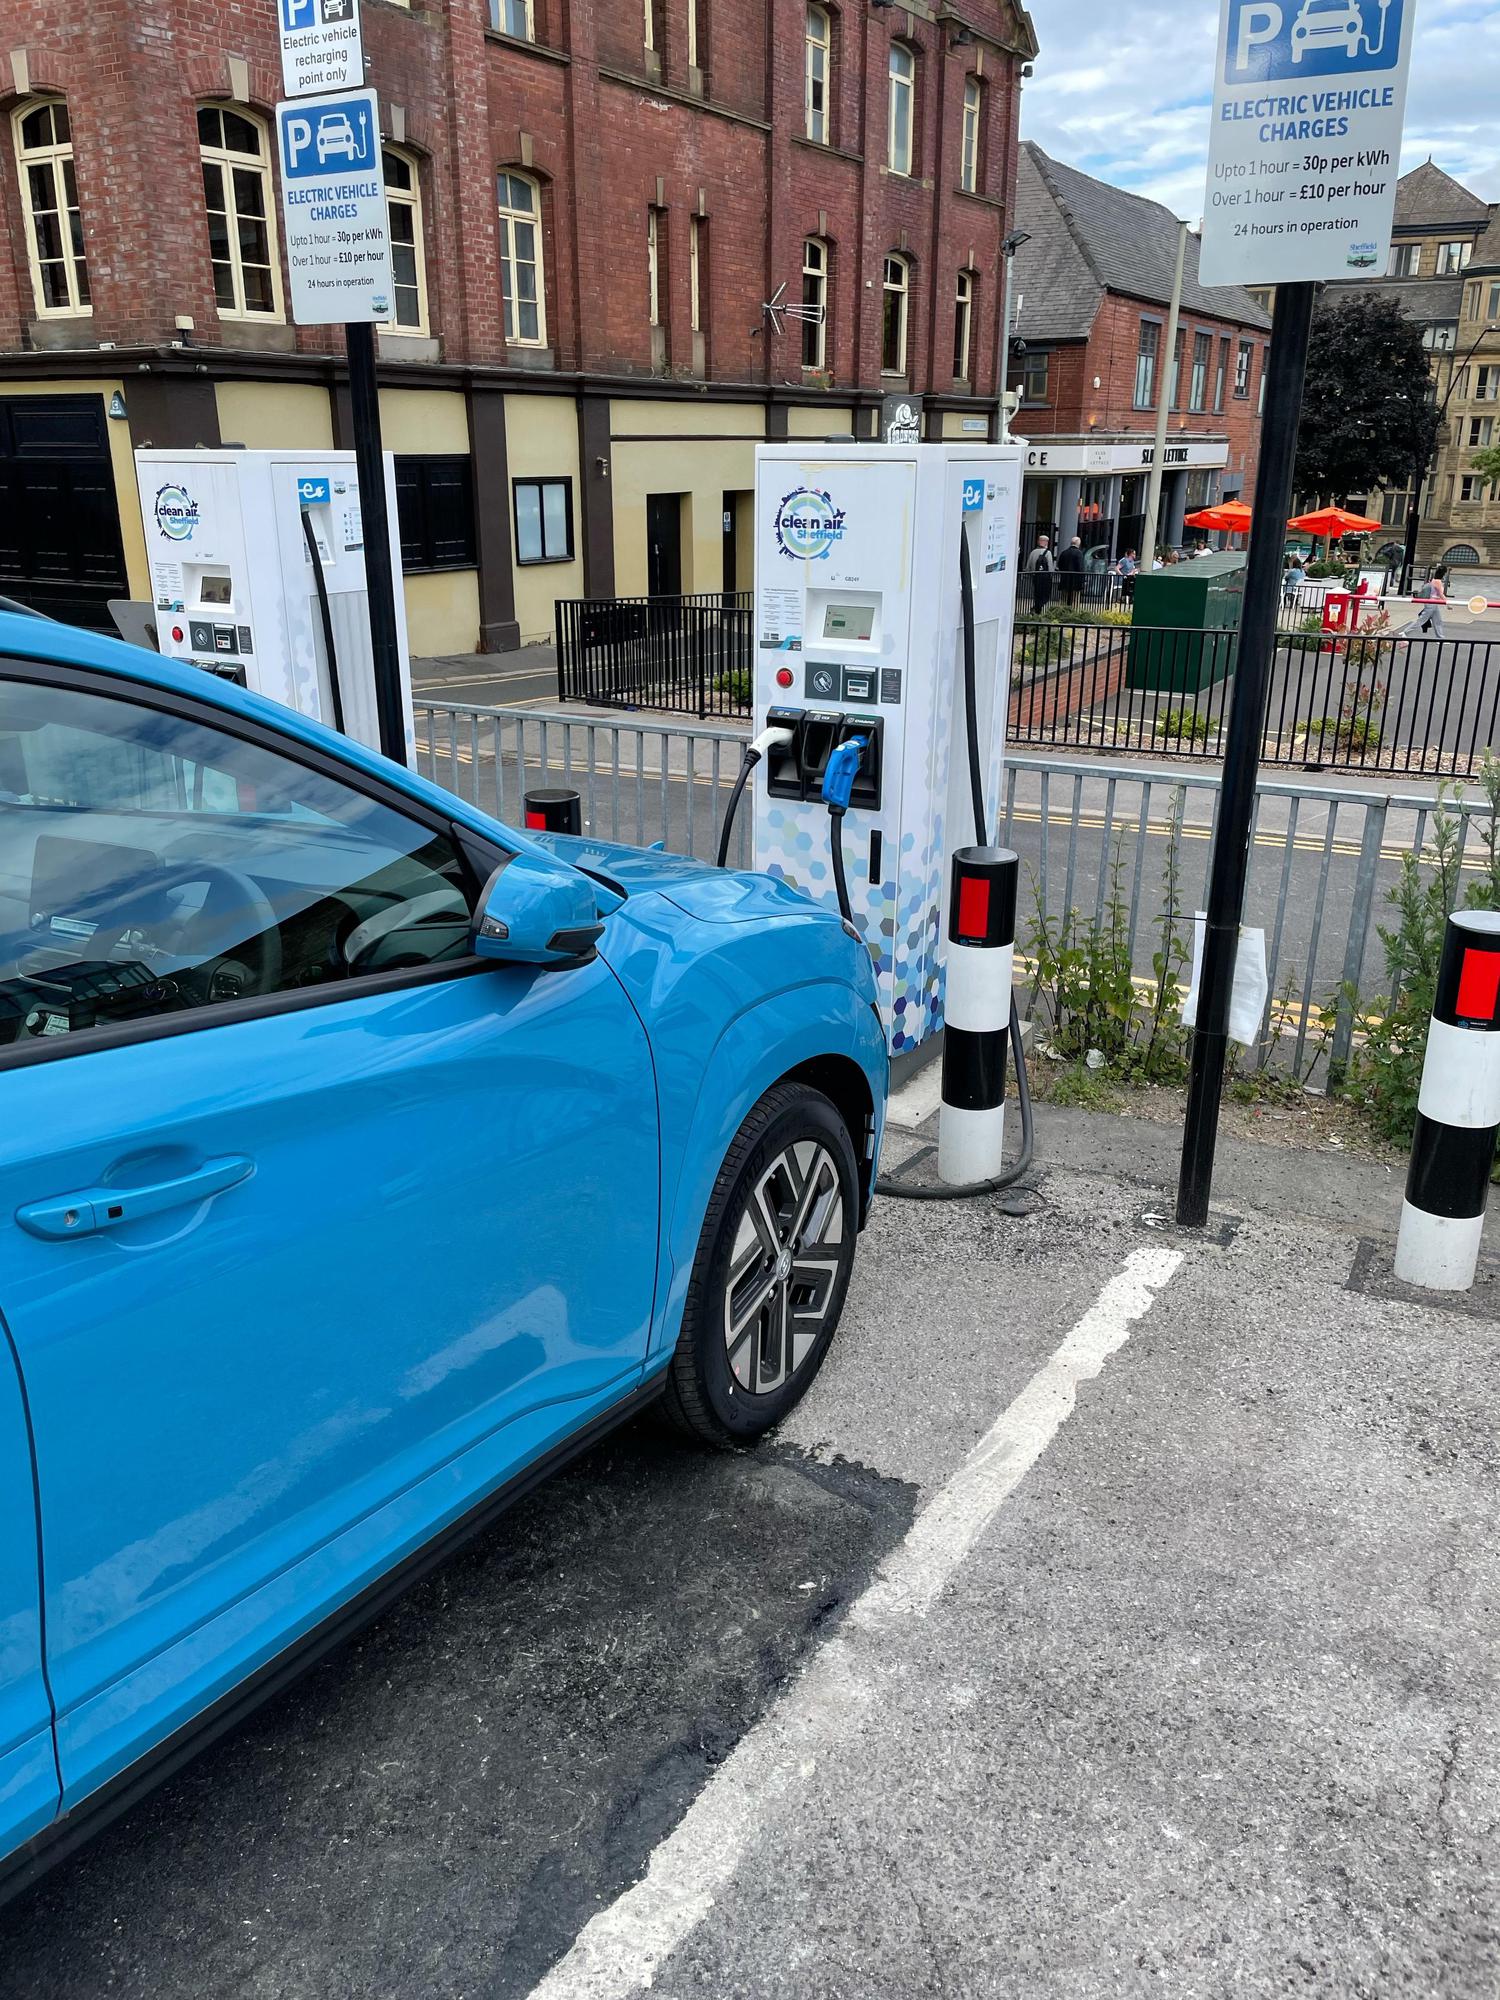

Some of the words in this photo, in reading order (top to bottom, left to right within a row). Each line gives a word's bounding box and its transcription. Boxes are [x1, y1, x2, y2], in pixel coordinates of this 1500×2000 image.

[287, 0, 308, 26] P
[283, 32, 320, 50] Electric
[322, 26, 358, 43] vehicle
[1236, 2, 1283, 71] P
[295, 48, 348, 67] recharging
[299, 70, 324, 88] point
[326, 67, 347, 82] only
[1221, 95, 1308, 121] ELECTRIC
[1312, 87, 1394, 113] VEHICLE
[1259, 117, 1348, 143] CHARGES
[287, 119, 311, 168] P
[1215, 163, 1246, 182] Upto
[1249, 161, 1256, 176] 1
[1259, 158, 1290, 175] hour
[1303, 155, 1328, 175] 30p
[1331, 154, 1354, 173] per
[1357, 150, 1390, 167] kWh
[288, 187, 333, 205] ELECTRIC
[334, 182, 379, 200] VEHICLE
[1212, 191, 1242, 207] Over
[1245, 190, 1252, 205] 1
[1255, 188, 1285, 204] hour
[1300, 184, 1325, 200] £10
[1327, 185, 1350, 202] per
[1353, 181, 1386, 196] hour
[310, 204, 358, 221] CHARGES
[1234, 223, 1248, 237] 24
[1251, 220, 1284, 236] hours
[1287, 220, 1298, 233] in
[1300, 218, 1359, 235] operation
[290, 235, 308, 249] Upto
[309, 234, 314, 245] 1
[314, 233, 331, 245] hour
[337, 231, 351, 245] 30p
[352, 231, 364, 243] per
[365, 228, 384, 241] kWh
[292, 255, 308, 267] Over
[309, 254, 314, 266] 1
[315, 254, 331, 265] hour
[339, 251, 353, 264] £10
[354, 252, 366, 266] per
[367, 250, 385, 262] hour
[307, 280, 316, 289] 24
[317, 278, 335, 288] hours
[336, 278, 343, 287] in
[343, 276, 375, 289] operation
[159, 505, 184, 517] clean
[185, 507, 198, 518] air
[170, 517, 199, 525] Sheffield
[781, 515, 820, 529] clean
[824, 517, 844, 530] air
[797, 529, 843, 540] Sheffield
